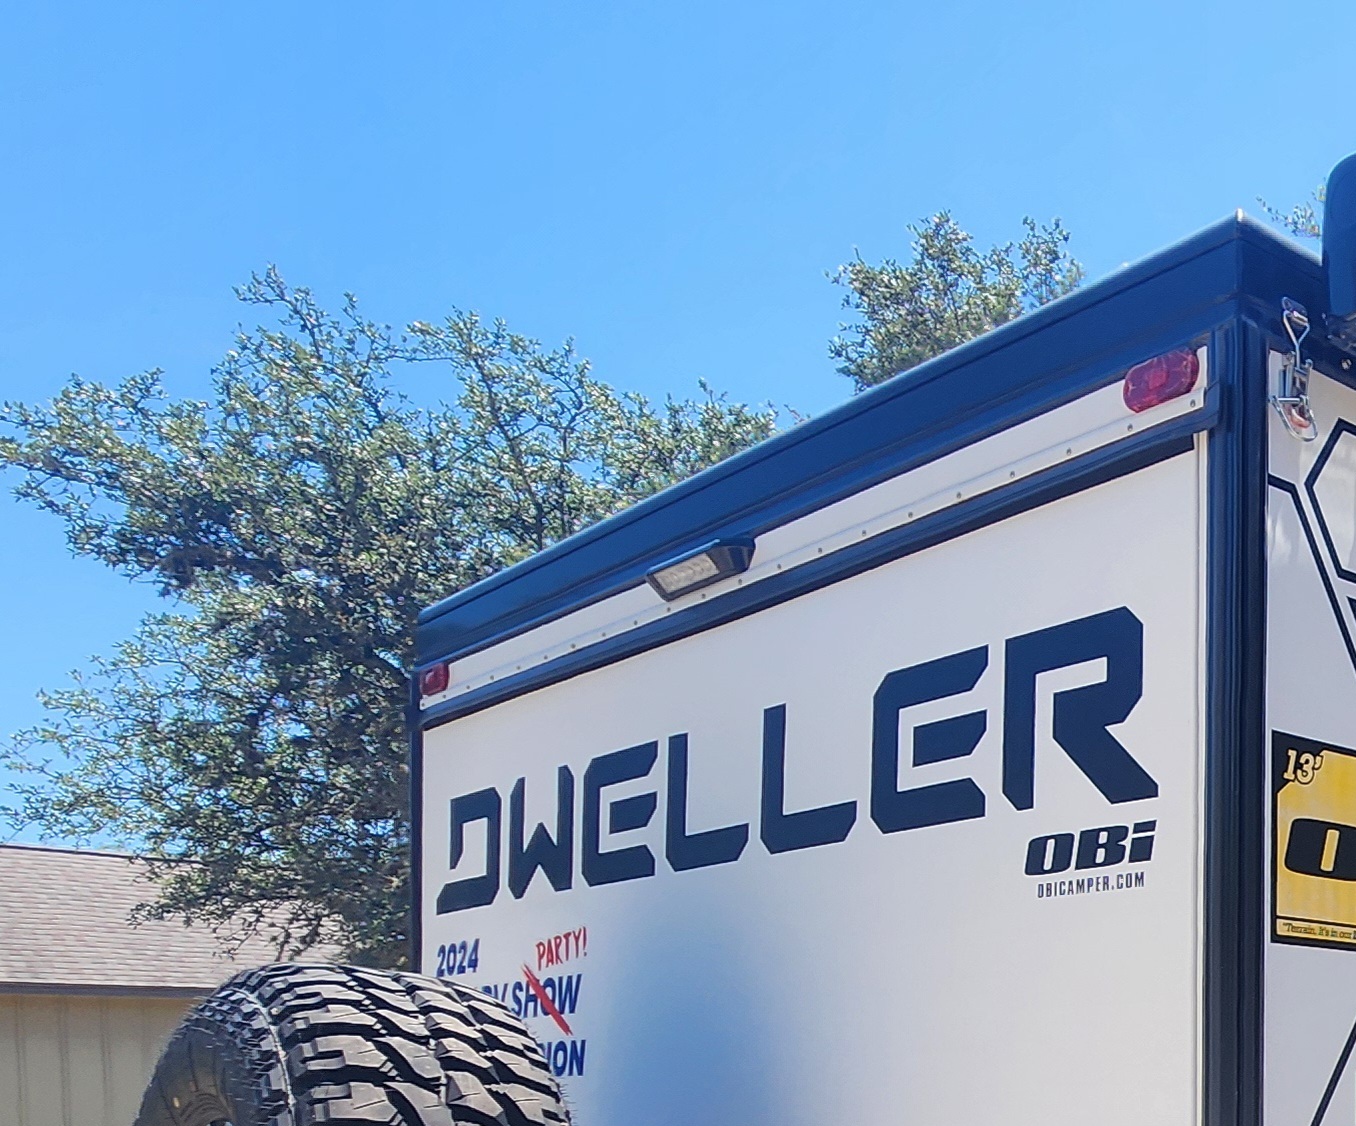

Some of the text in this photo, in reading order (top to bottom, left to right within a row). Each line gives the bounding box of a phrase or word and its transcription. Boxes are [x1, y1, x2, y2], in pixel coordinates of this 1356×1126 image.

[436, 606, 1159, 915] DWELLER
[1037, 871, 1145, 899] OBICAMPER.COM
[436, 938, 481, 978] 2024
[535, 926, 588, 972] PARTY!
[511, 973, 583, 1019] SHOW
